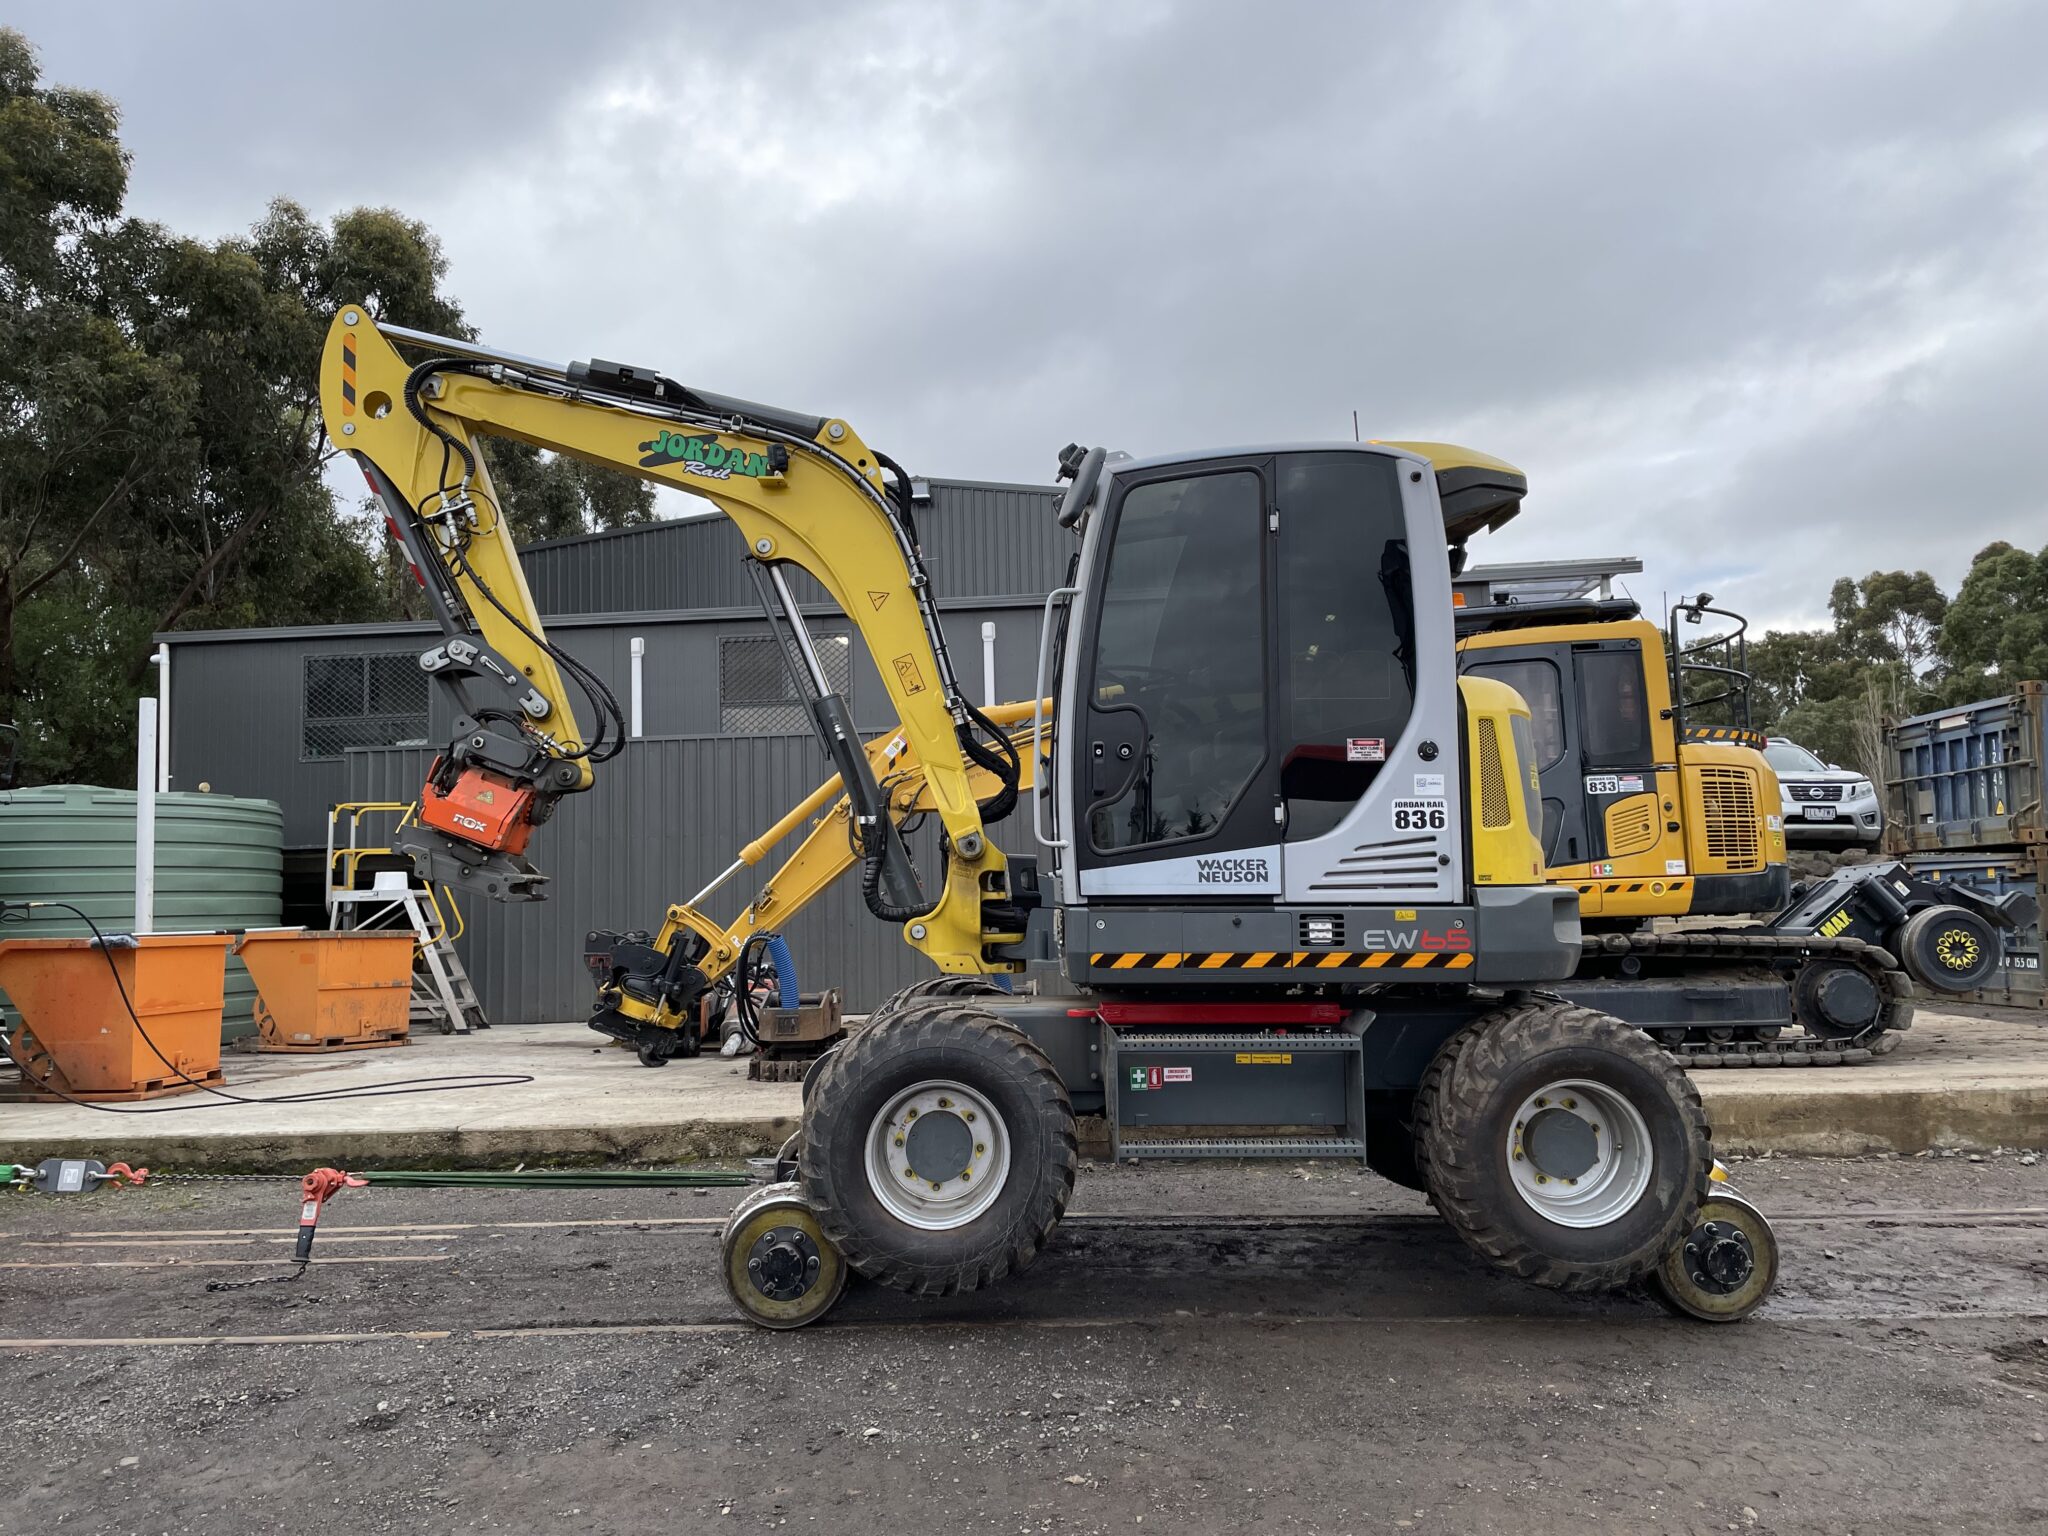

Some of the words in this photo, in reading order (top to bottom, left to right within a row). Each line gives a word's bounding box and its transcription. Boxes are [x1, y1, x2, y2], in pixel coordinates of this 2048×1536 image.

[651, 430, 769, 477] JORDAN
[683, 460, 732, 481] Rail
[1589, 781, 1616, 792] 833
[1395, 810, 1445, 829] 836
[1197, 859, 1268, 870] WACKER
[1199, 871, 1268, 882] NEUSON
[1820, 909, 1853, 938] MAX
[1363, 929, 1472, 949] EW65
